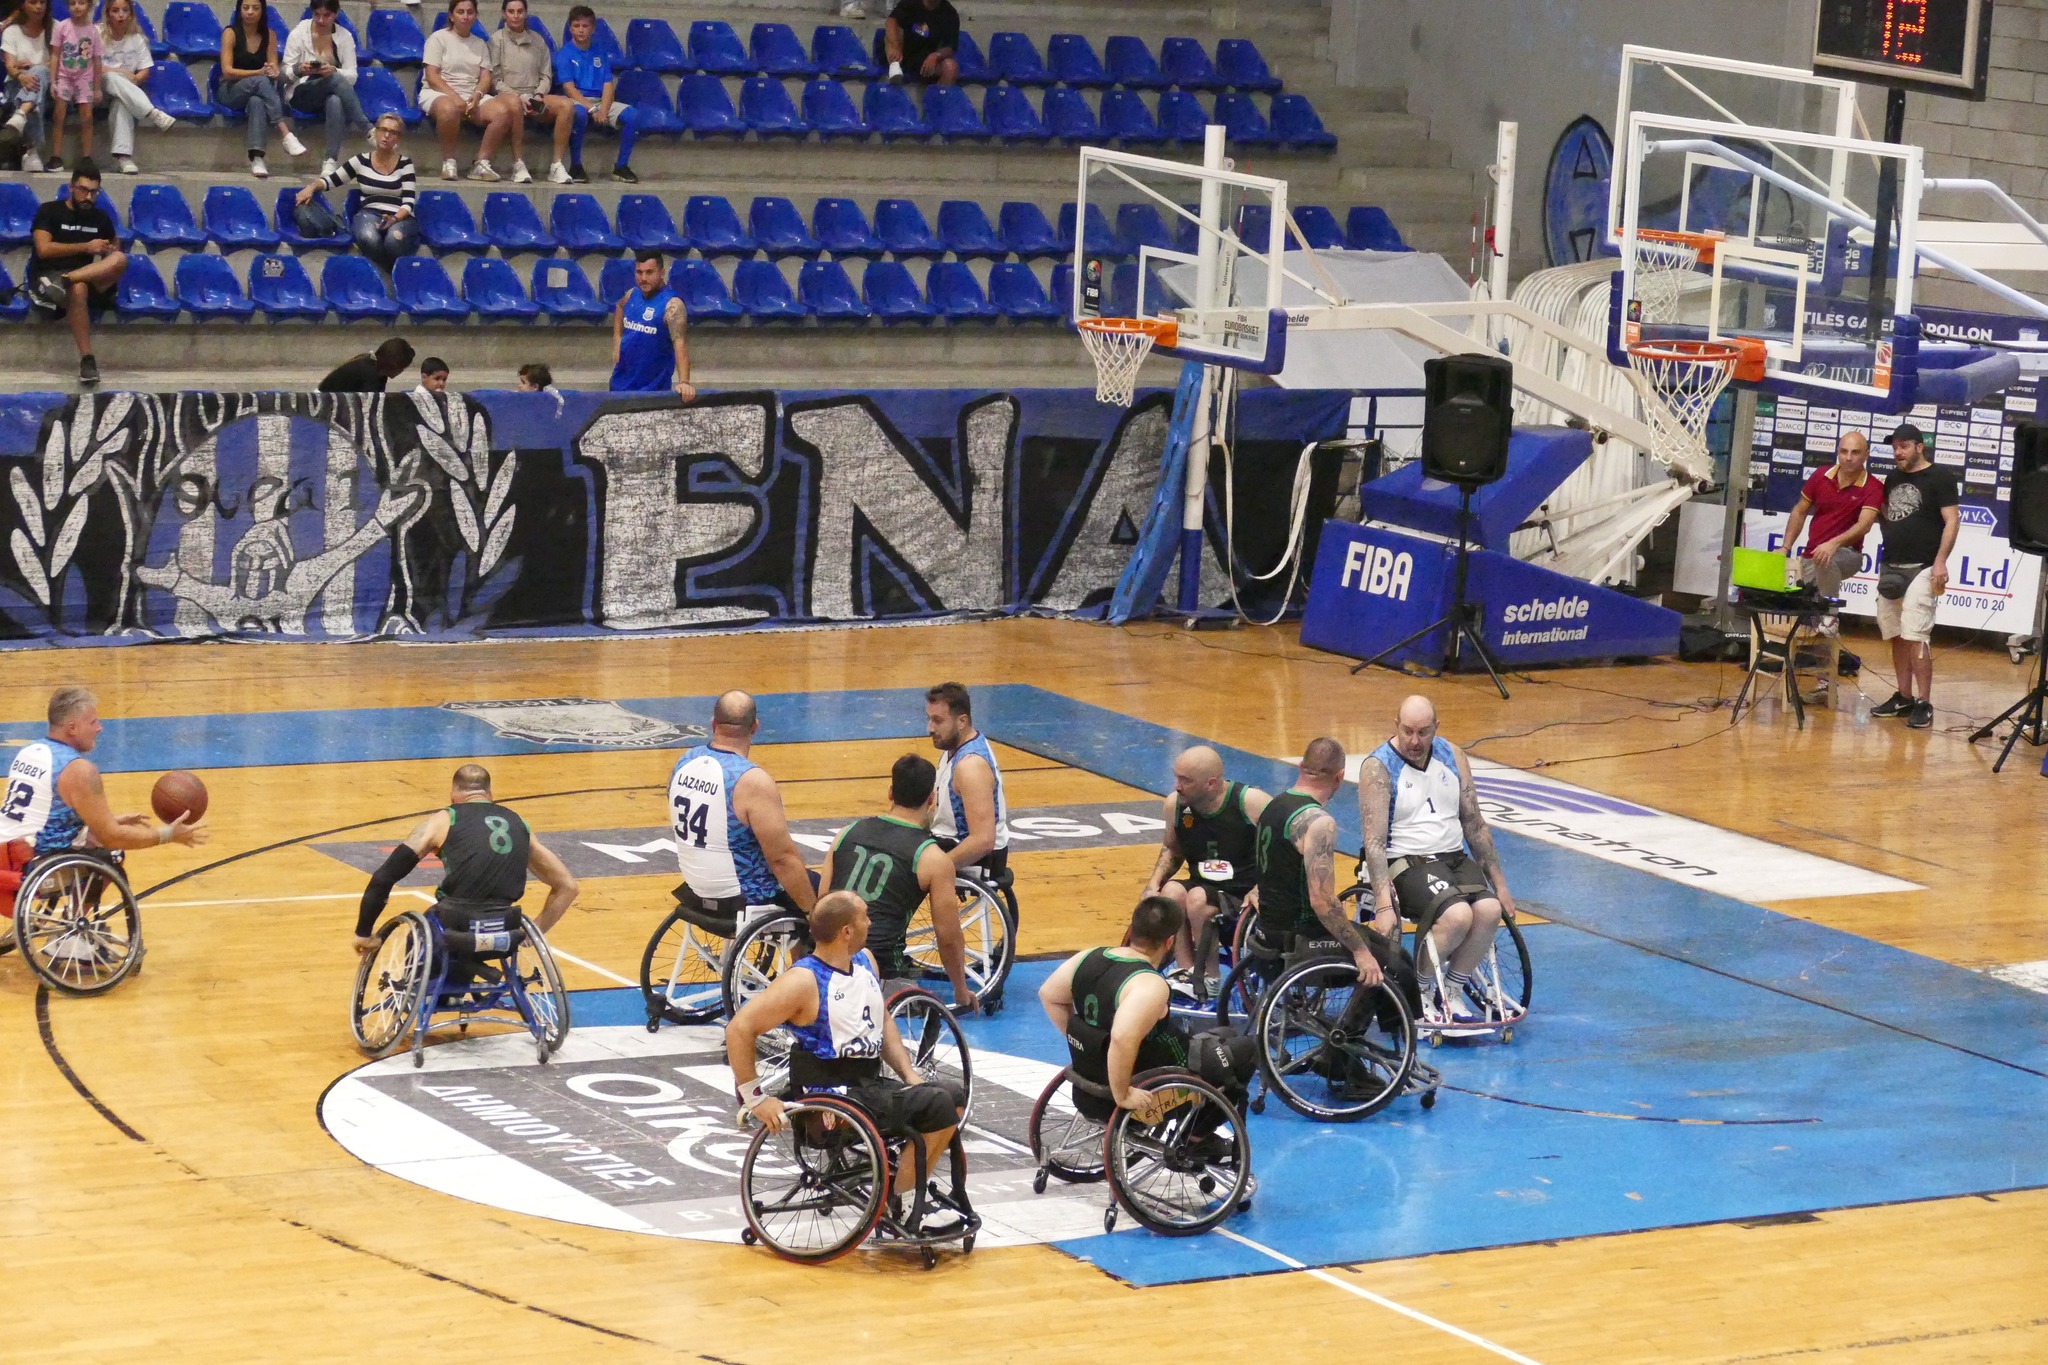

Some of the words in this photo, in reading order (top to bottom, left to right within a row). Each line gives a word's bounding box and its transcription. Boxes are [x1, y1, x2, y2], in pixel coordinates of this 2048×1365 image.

[1086, 286, 1100, 298] FIBA
[1224, 320, 1260, 335] EUROBASKET
[1803, 311, 1845, 327] TILES
[1777, 422, 1802, 431] DIMCO
[1341, 541, 1413, 601] FIBA
[1503, 596, 1589, 623] schelde
[1946, 594, 1973, 608] 7000
[1975, 597, 1988, 609] 70
[1991, 600, 2005, 612] 20
[1501, 625, 1589, 646] international
[12, 760, 47, 779] BOBBY
[677, 773, 719, 796] LAZAROU
[1, 779, 35, 823] 12
[1426, 797, 1436, 814] 1
[674, 795, 709, 849] 34
[484, 815, 513, 855] 8
[1256, 821, 1273, 874] 13
[844, 845, 894, 903] 10
[1203, 860, 1229, 872] Dole
[1308, 940, 1342, 950] EXTRA
[862, 1005, 875, 1030] 9
[1068, 1034, 1085, 1052] EXTRA
[1215, 1046, 1230, 1069] EXTRA
[1145, 1100, 1178, 1120] EXTRA
[418, 1086, 676, 1189] ΔΗΜΙΟΥΡΓΙΕΣ
